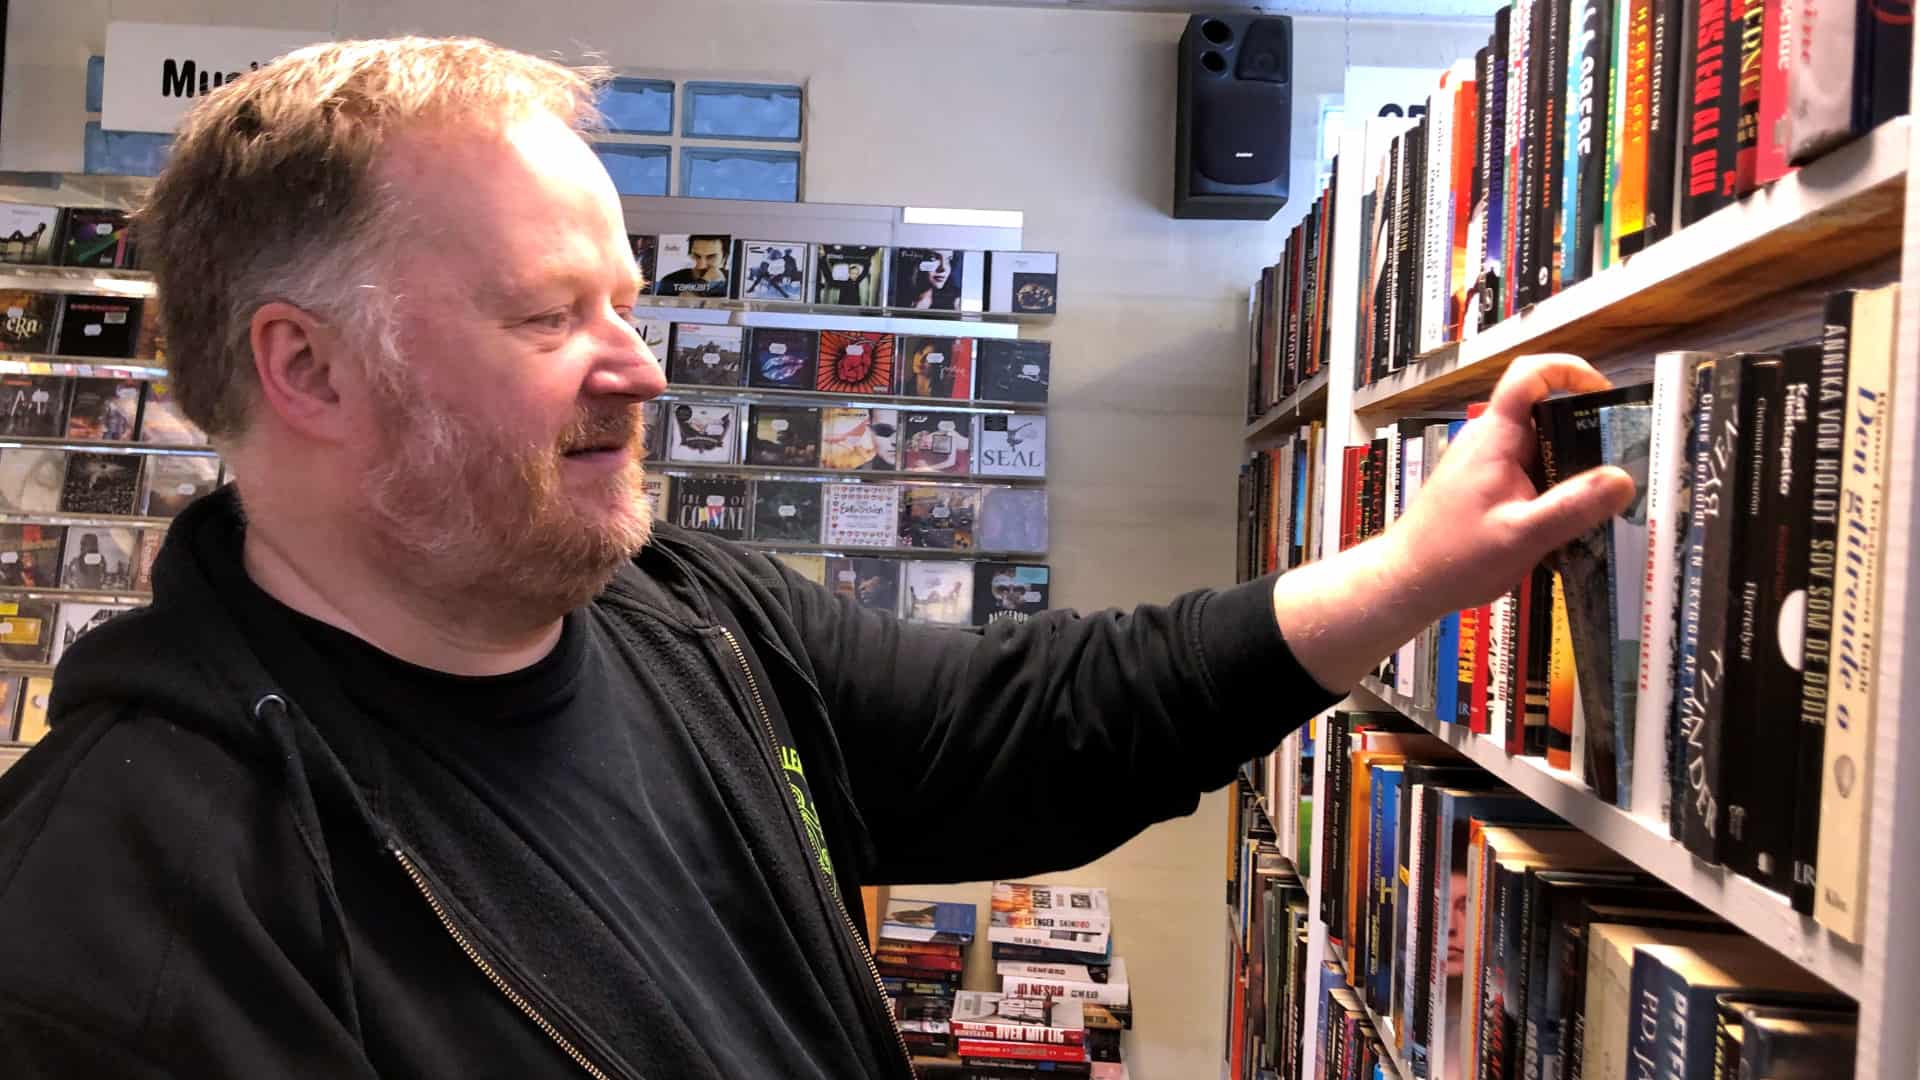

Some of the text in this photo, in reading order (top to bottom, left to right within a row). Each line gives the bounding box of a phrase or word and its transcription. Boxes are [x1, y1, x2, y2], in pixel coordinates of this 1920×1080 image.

[1650, 14, 1664, 131] TOUCHDOWN
[1696, 393, 1714, 443] Claus
[1795, 383, 1809, 421] Kati
[1853, 386, 1878, 475] Den
[981, 449, 1042, 467] SEAL
[1800, 324, 1847, 726] ANNIKA VON HOLDT SOV SOM DE DØDE
[996, 1023, 1023, 1040] OVER
[1026, 1027, 1048, 1042] MIT
[1641, 990, 1659, 1042] P.D.
